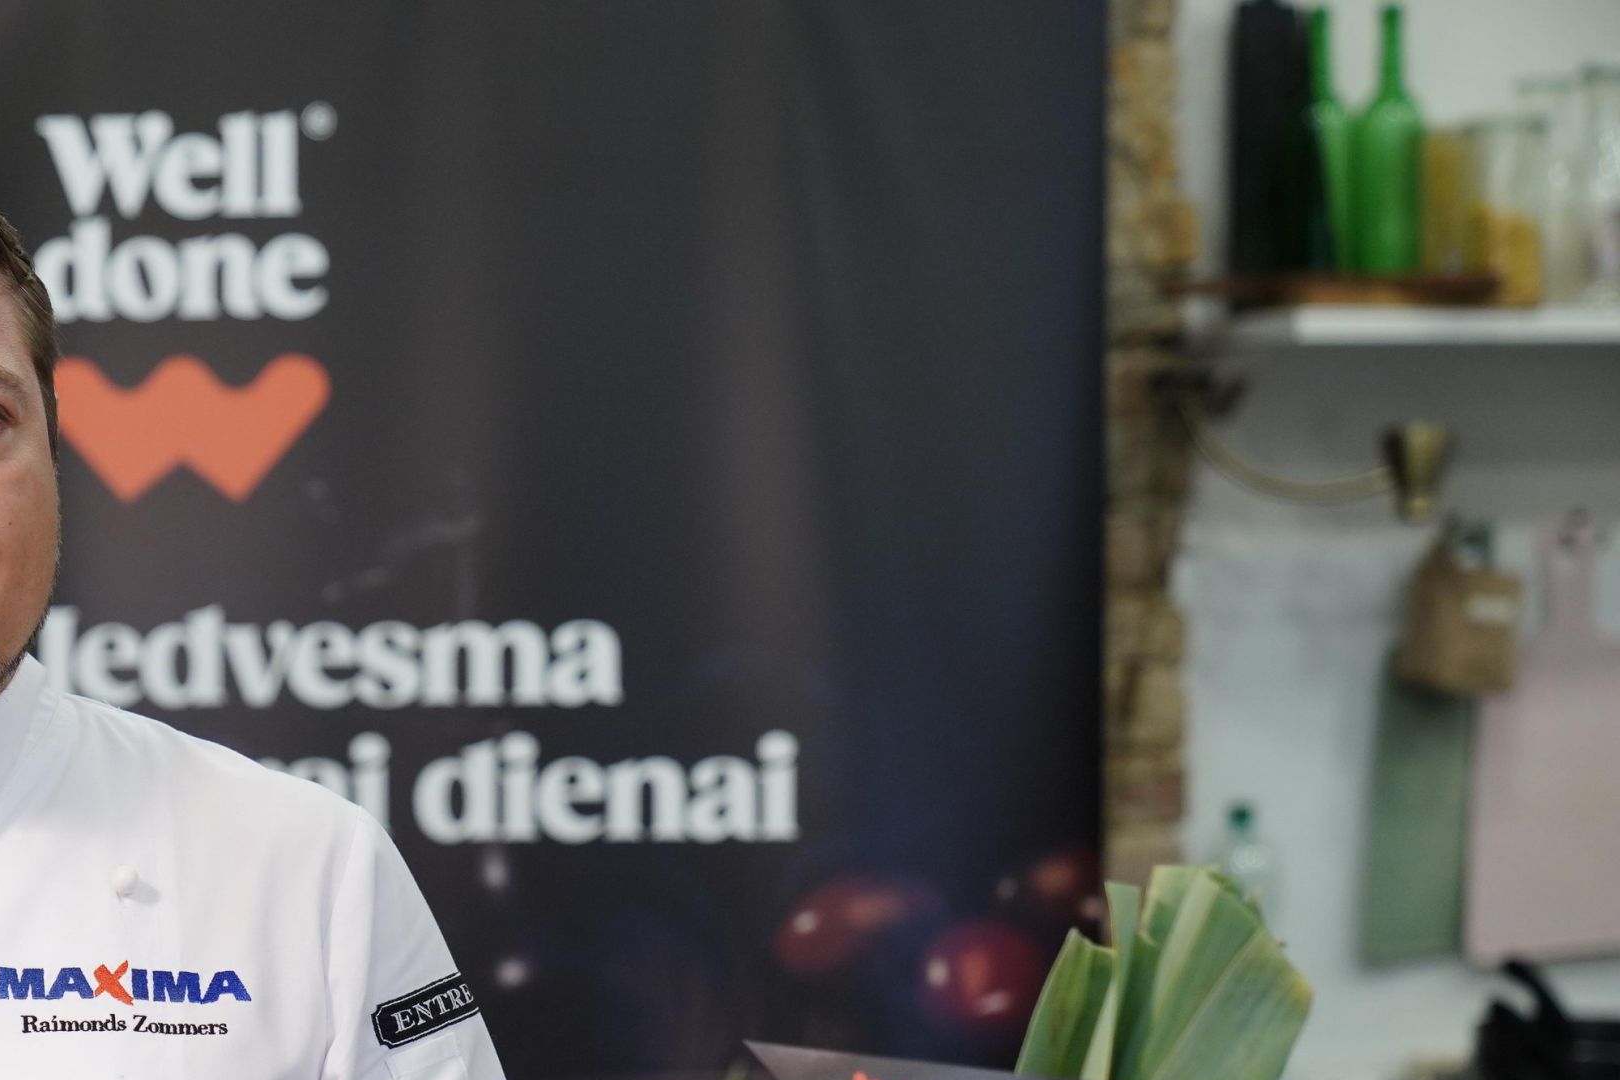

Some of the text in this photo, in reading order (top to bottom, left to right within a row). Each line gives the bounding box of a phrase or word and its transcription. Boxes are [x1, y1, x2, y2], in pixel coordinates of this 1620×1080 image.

[33, 214, 332, 324] done
[411, 728, 802, 846] dienai
[21, 1013, 229, 1036] Raimonds Zommers
